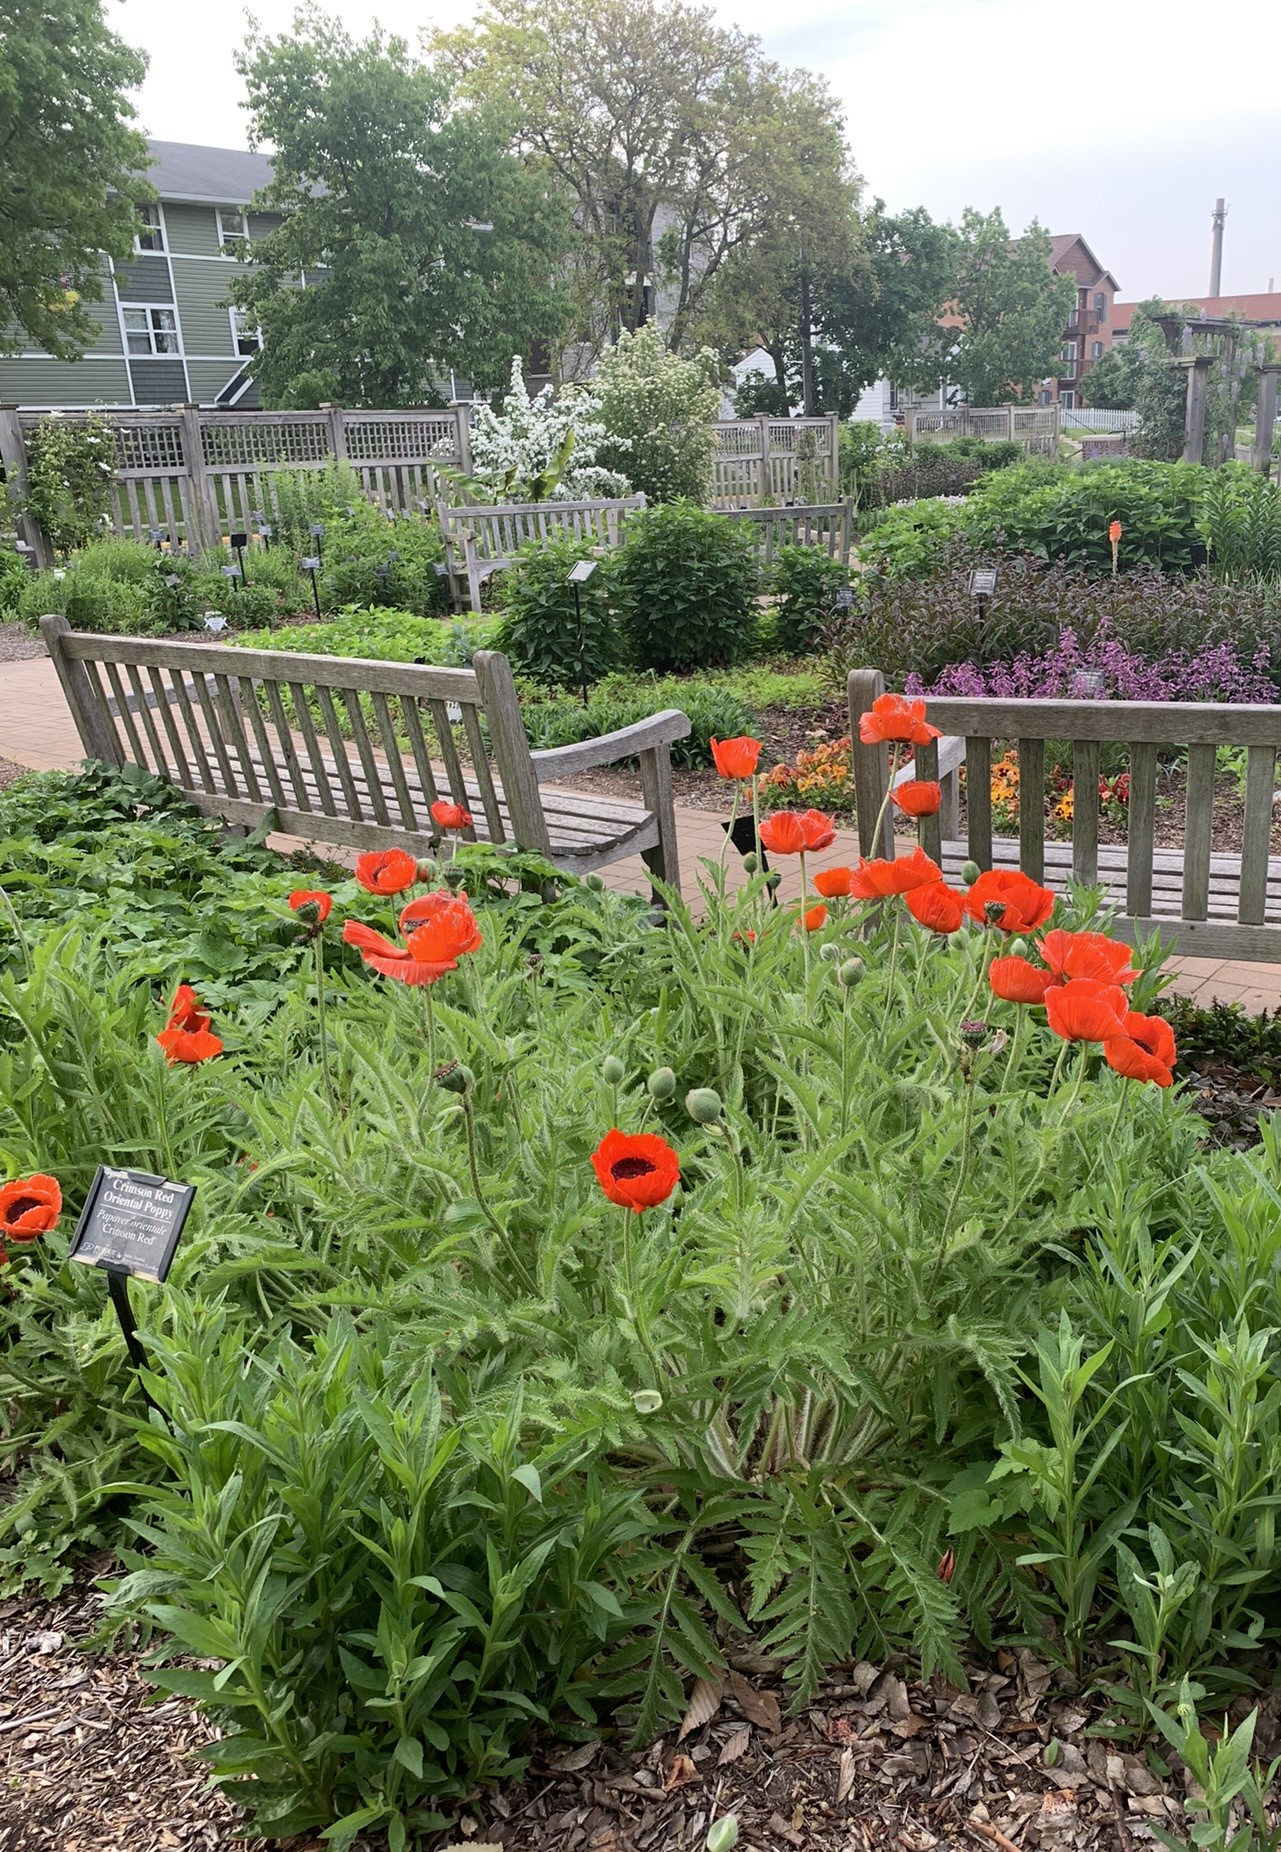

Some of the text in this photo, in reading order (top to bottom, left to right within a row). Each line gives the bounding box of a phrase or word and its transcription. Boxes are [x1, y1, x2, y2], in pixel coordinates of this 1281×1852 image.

[104, 1190, 174, 1220] Oriental Poppy
[113, 1179, 174, 1204] Crimson Red
[97, 1209, 168, 1236] Papaver orientale
